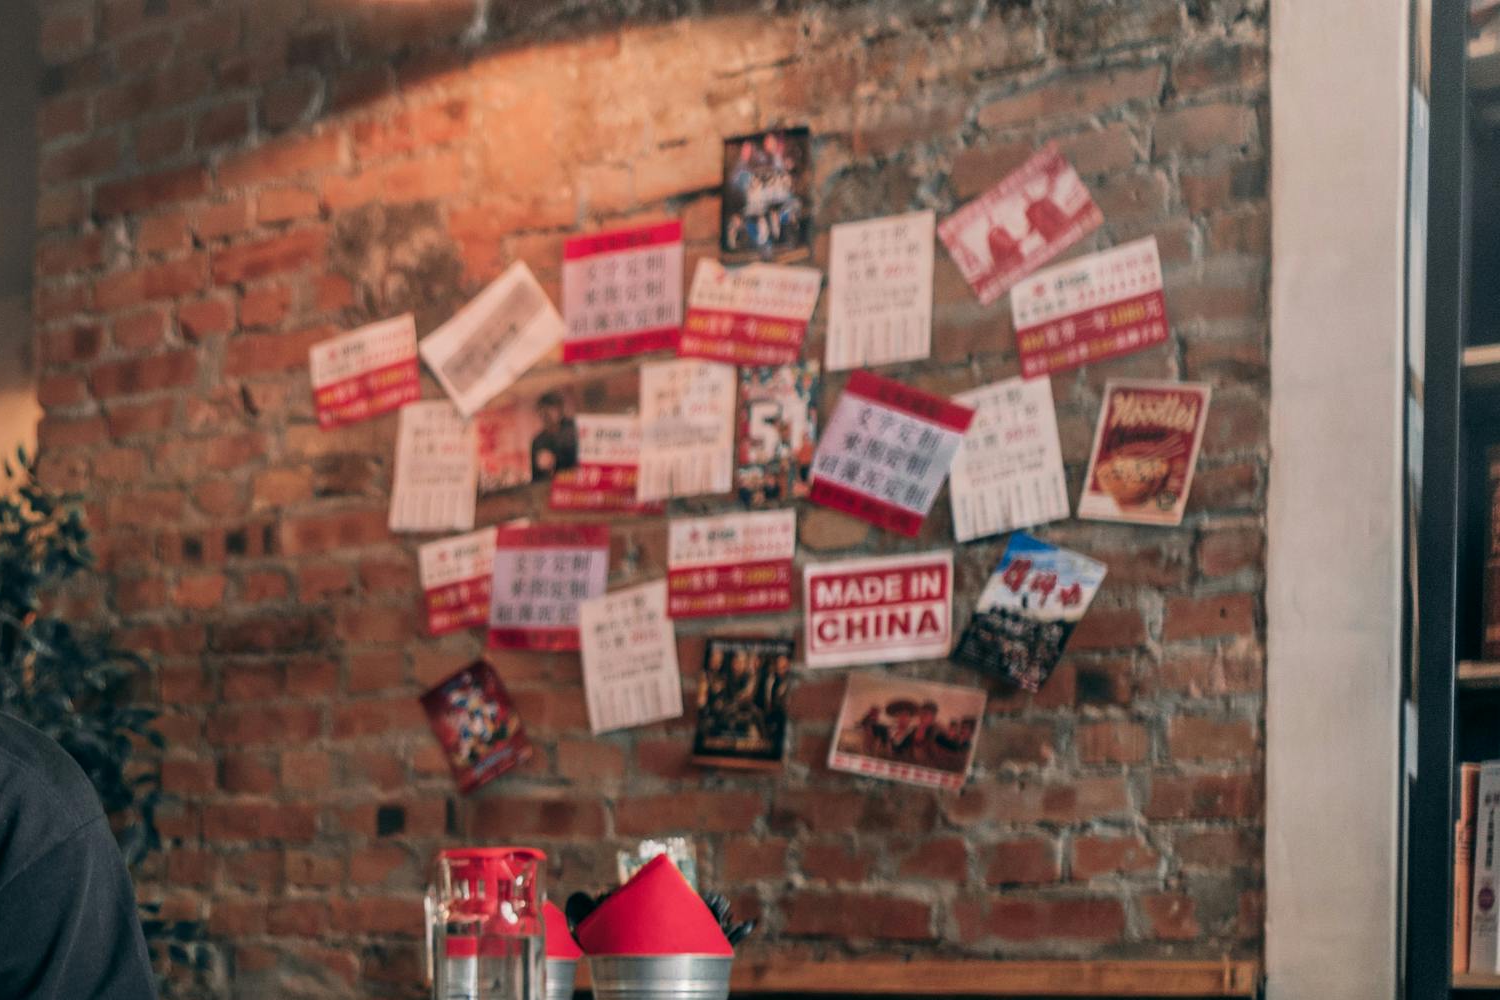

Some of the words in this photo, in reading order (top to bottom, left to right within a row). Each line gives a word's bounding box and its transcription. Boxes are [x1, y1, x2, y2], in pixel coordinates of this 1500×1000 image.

[816, 574, 903, 608] MADE
[910, 570, 942, 599] IN
[818, 609, 940, 642] CHINA
